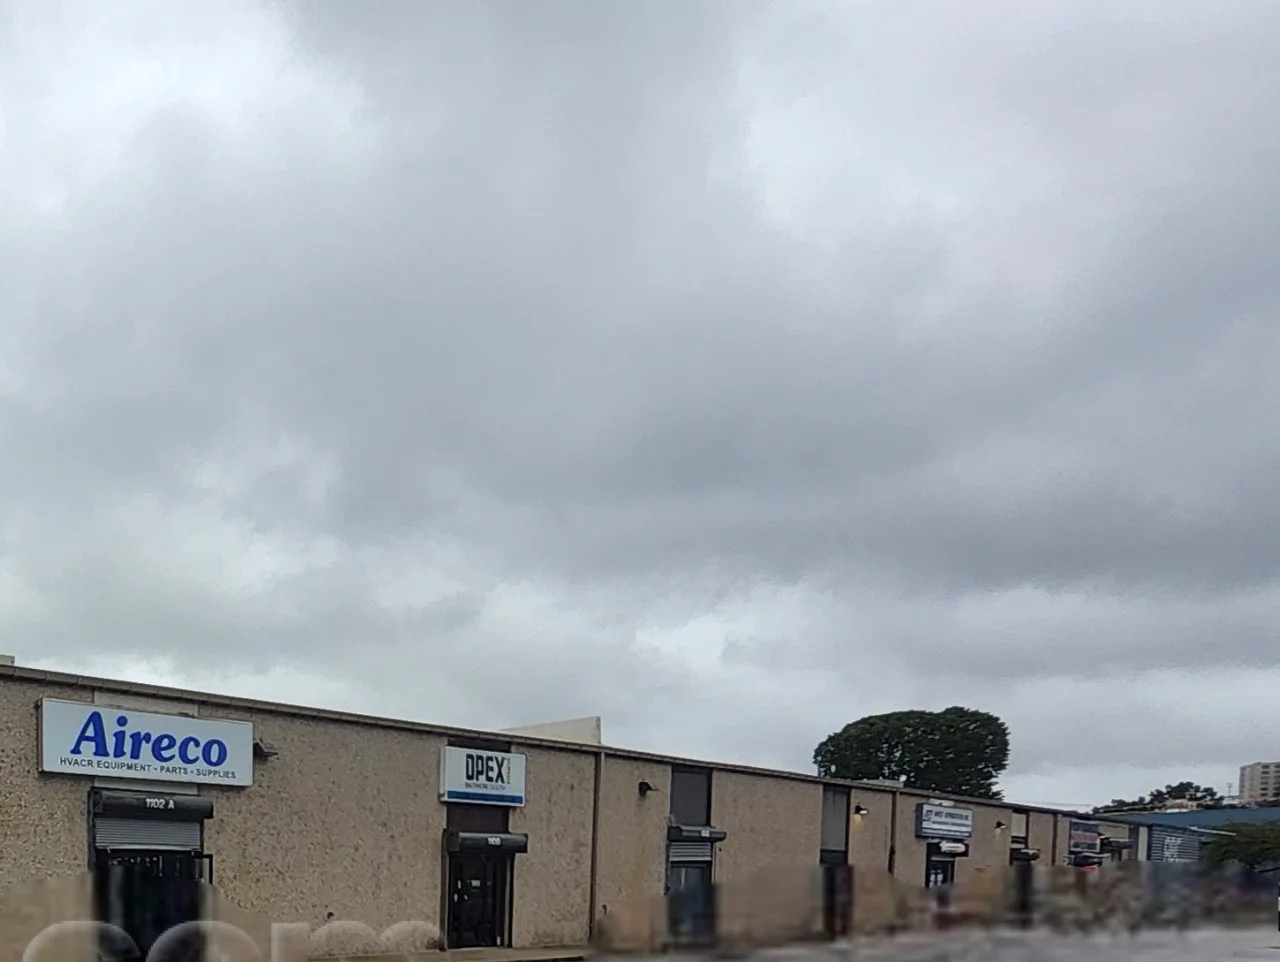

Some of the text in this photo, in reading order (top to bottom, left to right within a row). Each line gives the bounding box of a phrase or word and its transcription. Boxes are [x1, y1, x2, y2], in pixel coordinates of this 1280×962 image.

[70, 711, 227, 767] Aireco
[60, 757, 237, 779] HVACR EQUIPMENT PARTS SUPPLIES
[465, 753, 506, 784] OPEX
[146, 798, 175, 810] 1102 A
